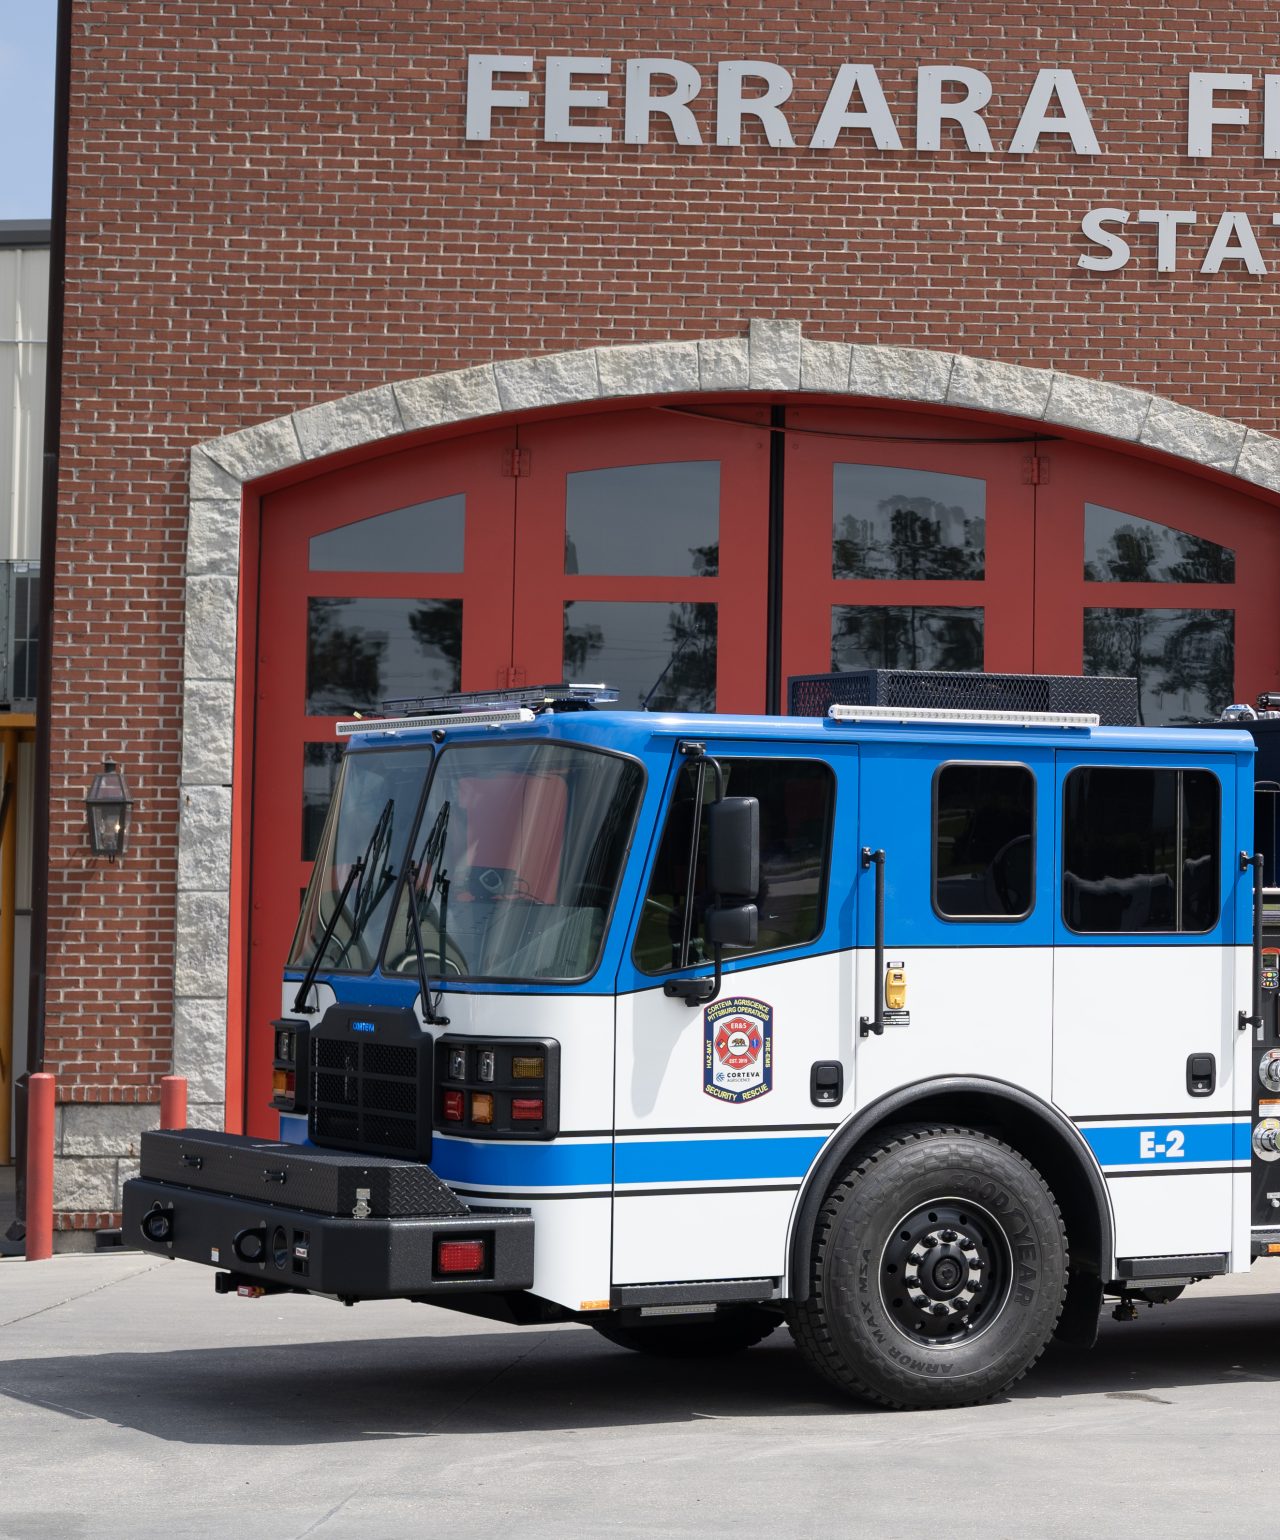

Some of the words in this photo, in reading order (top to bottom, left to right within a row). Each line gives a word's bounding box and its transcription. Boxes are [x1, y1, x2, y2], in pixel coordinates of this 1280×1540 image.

[465, 54, 1102, 156] FERRARA
[707, 1007, 737, 1022] PITTSBURG
[737, 1006, 770, 1021] OPERATIONS
[708, 1000, 732, 1014] CORTEVA
[734, 999, 770, 1013] AGRISCIENCE
[705, 1084, 738, 1101] SECURITY
[742, 1083, 769, 1100] RESCUE
[1140, 1129, 1185, 1158] E-2
[951, 1174, 1037, 1307] GOODYEAR
[861, 1301, 887, 1344] MAX
[888, 1346, 954, 1374] ARMOR
